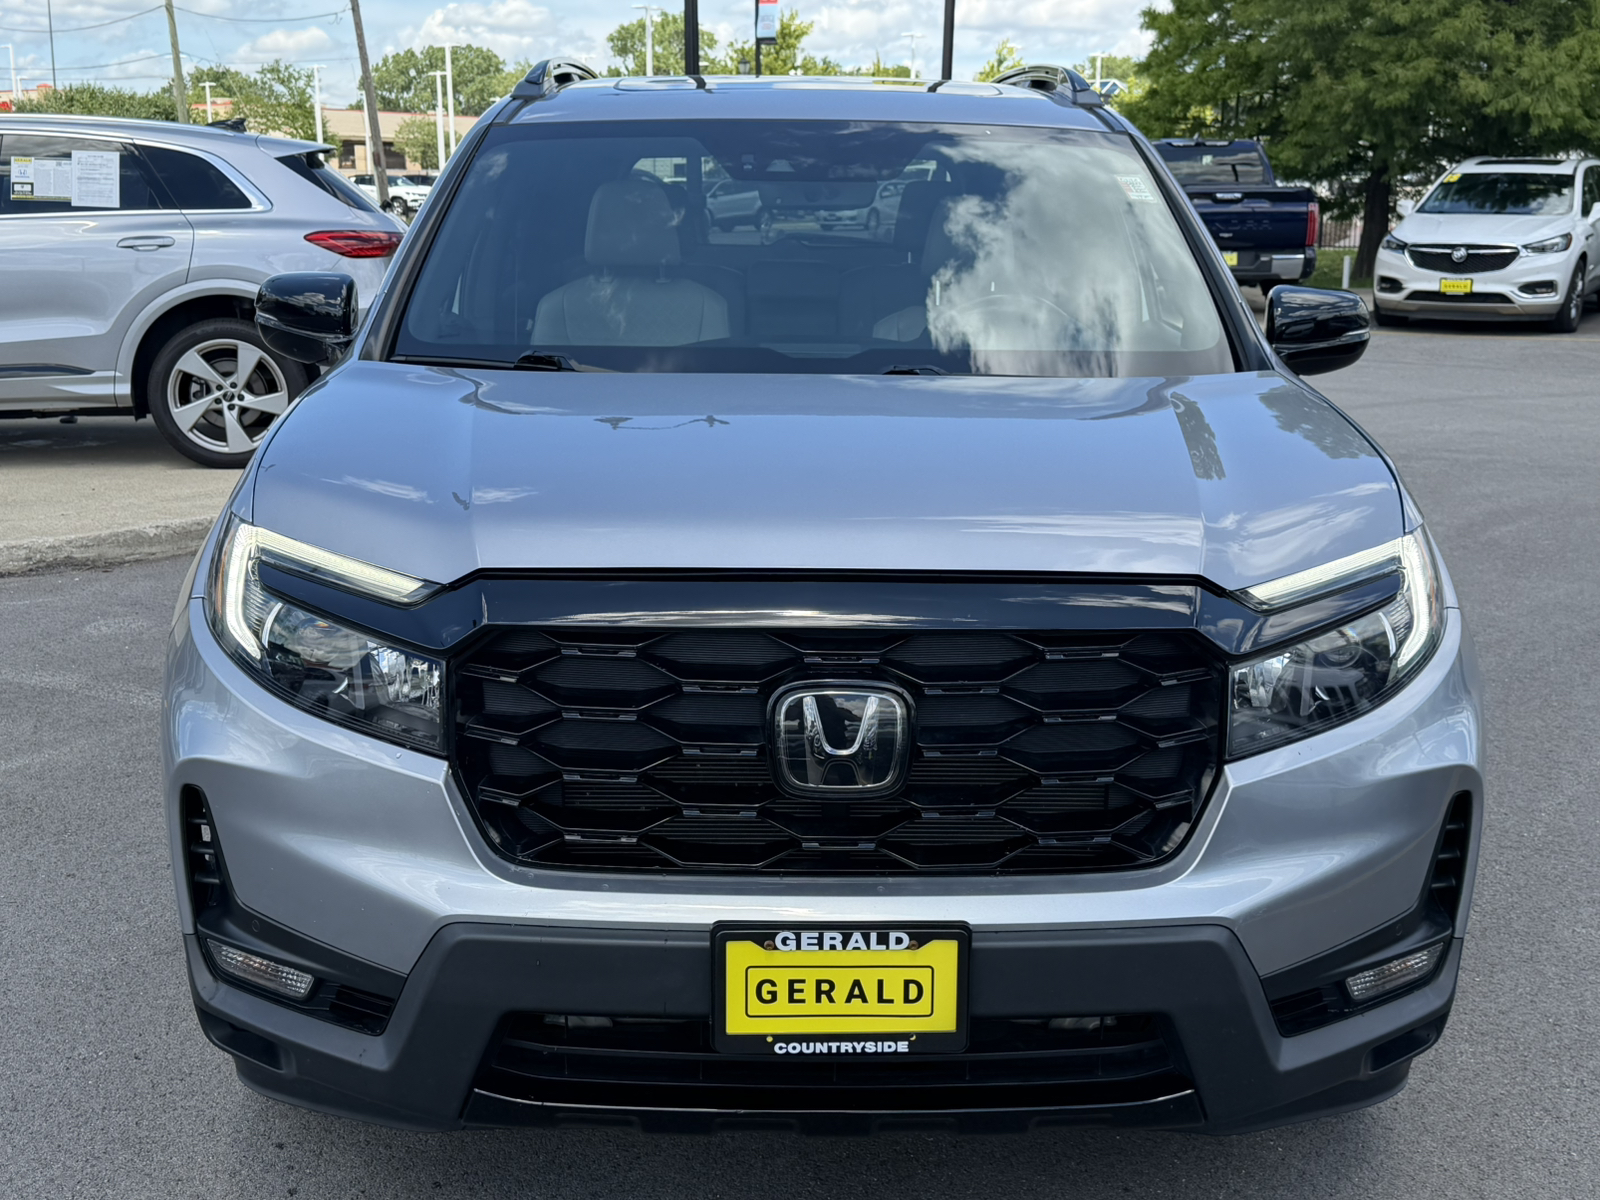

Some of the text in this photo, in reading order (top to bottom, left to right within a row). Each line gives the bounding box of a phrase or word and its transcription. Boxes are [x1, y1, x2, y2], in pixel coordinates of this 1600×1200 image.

[774, 931, 910, 951] GERALD
[755, 978, 924, 1005] GERALD
[773, 1040, 909, 1054] COUNTRYSIDE
